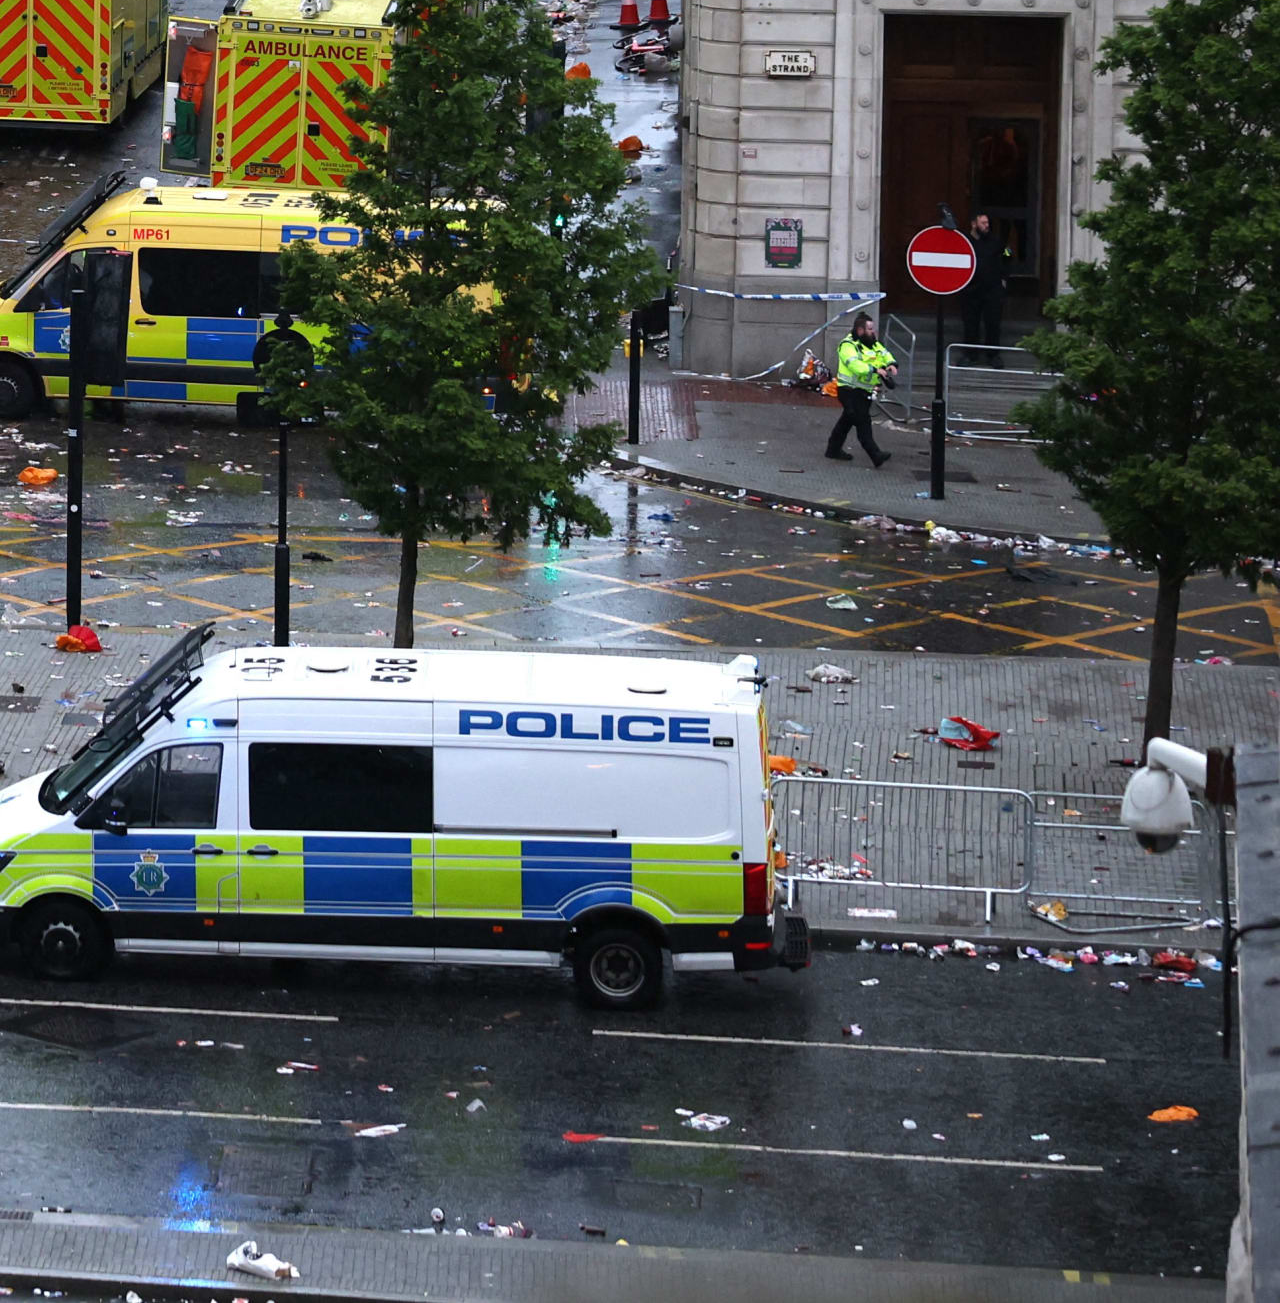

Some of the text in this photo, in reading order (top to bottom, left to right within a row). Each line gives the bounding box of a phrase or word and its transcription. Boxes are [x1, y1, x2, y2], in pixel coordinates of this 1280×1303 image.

[244, 39, 368, 61] AMBULANCE
[781, 55, 800, 63] THE
[772, 65, 809, 73] STRAND
[133, 228, 170, 240] MP61
[458, 709, 711, 744] POLICE
